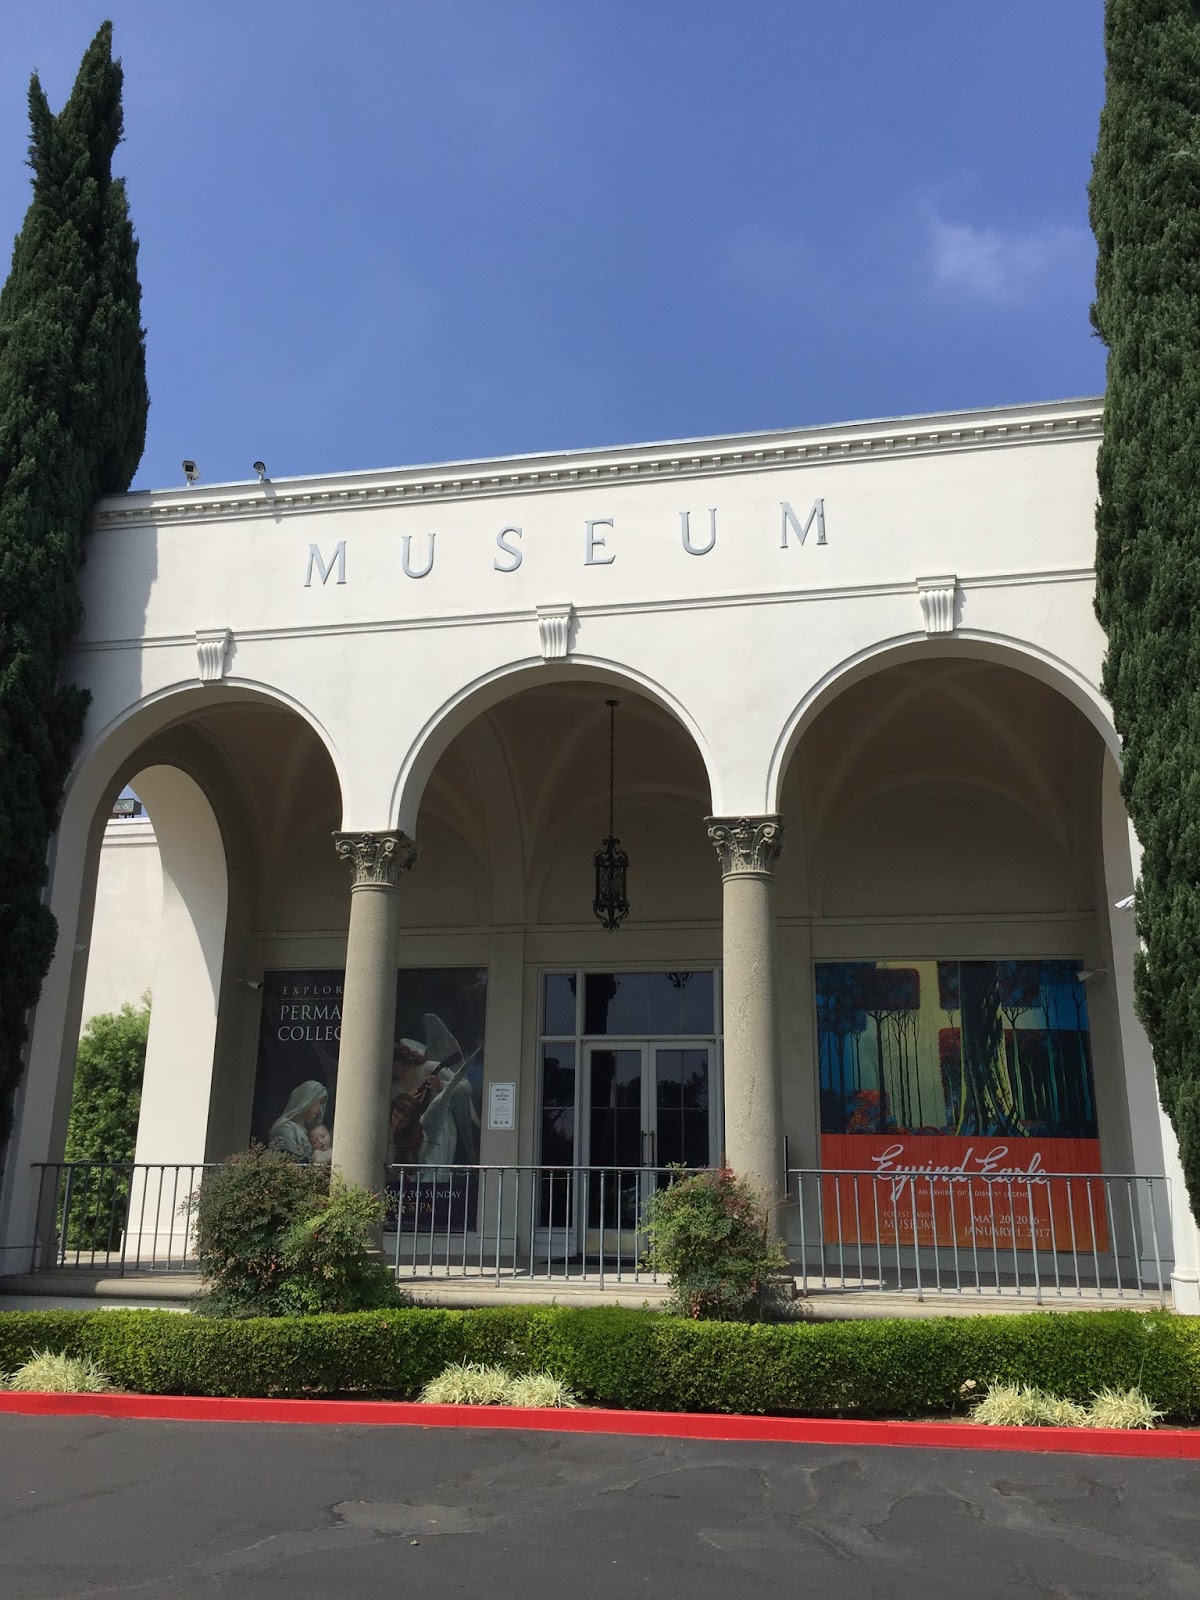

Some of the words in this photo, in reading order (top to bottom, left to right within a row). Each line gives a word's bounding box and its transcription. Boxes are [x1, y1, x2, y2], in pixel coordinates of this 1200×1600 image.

[304, 498, 827, 588] MUSEUM
[283, 986, 343, 995] EXPLOR
[280, 1005, 342, 1020] PERMA
[278, 1026, 341, 1041] COLLEC
[872, 1144, 973, 1201] Eyvind
[975, 1146, 1049, 1184] Earle
[883, 1210, 910, 1218] FOEST
[1016, 1215, 1040, 1225] 206
